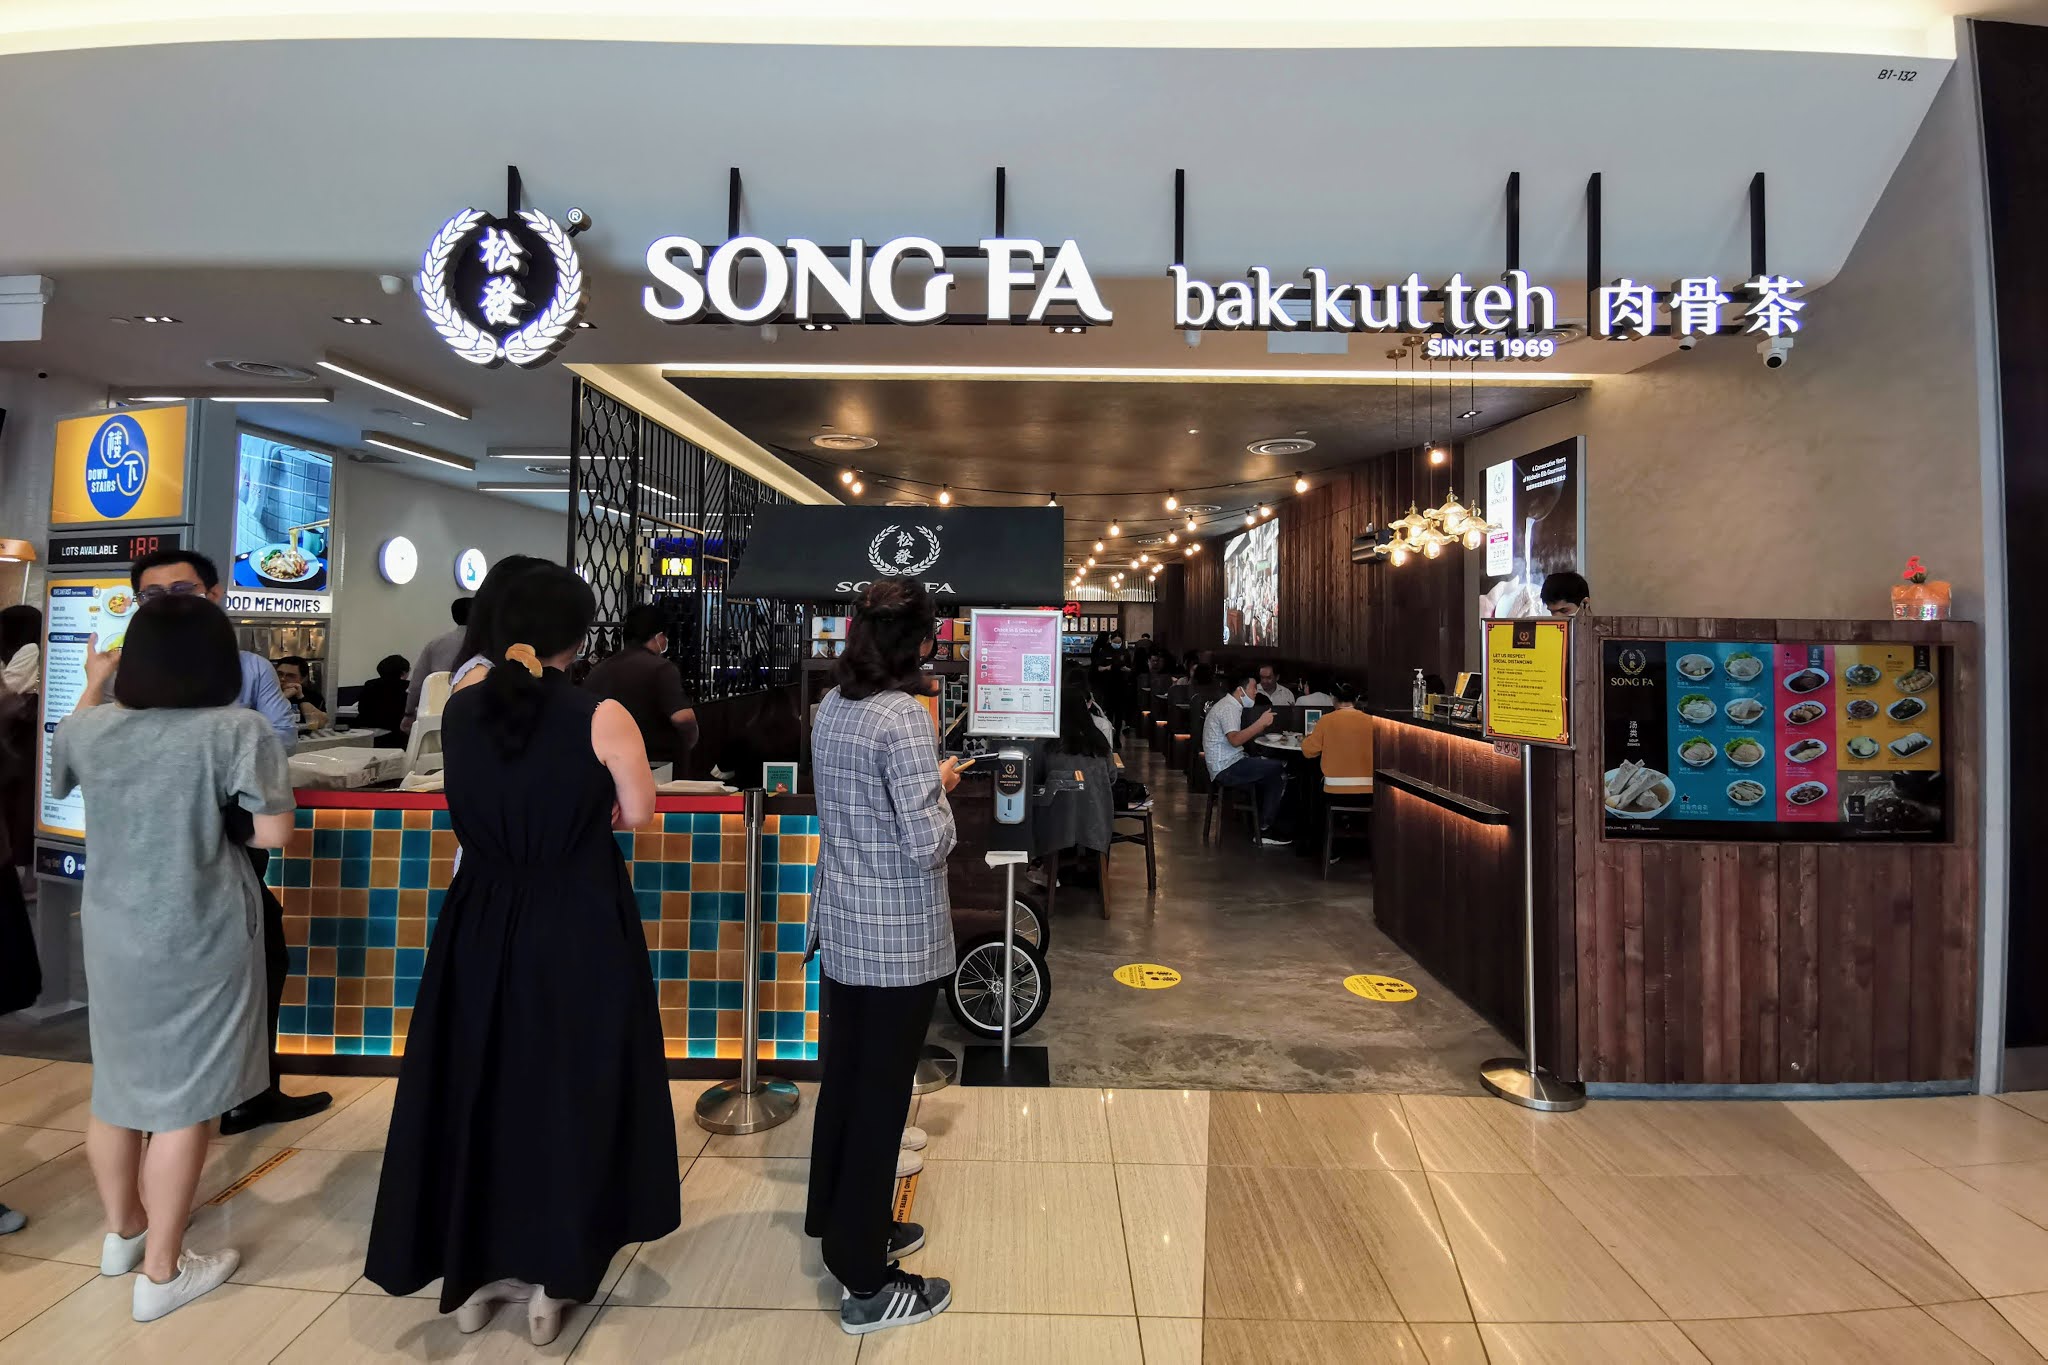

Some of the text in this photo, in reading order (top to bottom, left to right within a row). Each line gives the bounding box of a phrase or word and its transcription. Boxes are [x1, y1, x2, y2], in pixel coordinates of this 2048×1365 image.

[1877, 69, 1918, 82] B1-132
[479, 226, 527, 326] 松發
[643, 235, 1113, 325] SONG FA
[1168, 264, 1556, 331] bak kut teh
[1599, 275, 1807, 337] 肉骨茶
[1427, 338, 1554, 357] SINCE 1969
[88, 468, 108, 482] DOWN
[91, 481, 116, 493] STAIRS
[62, 546, 79, 556] LOTS
[80, 544, 118, 556] AVAILABLE
[893, 530, 915, 566] 松發
[923, 582, 957, 594] FA
[255, 597, 321, 612] MEMORIES
[1611, 677, 1654, 687] SONG FA
